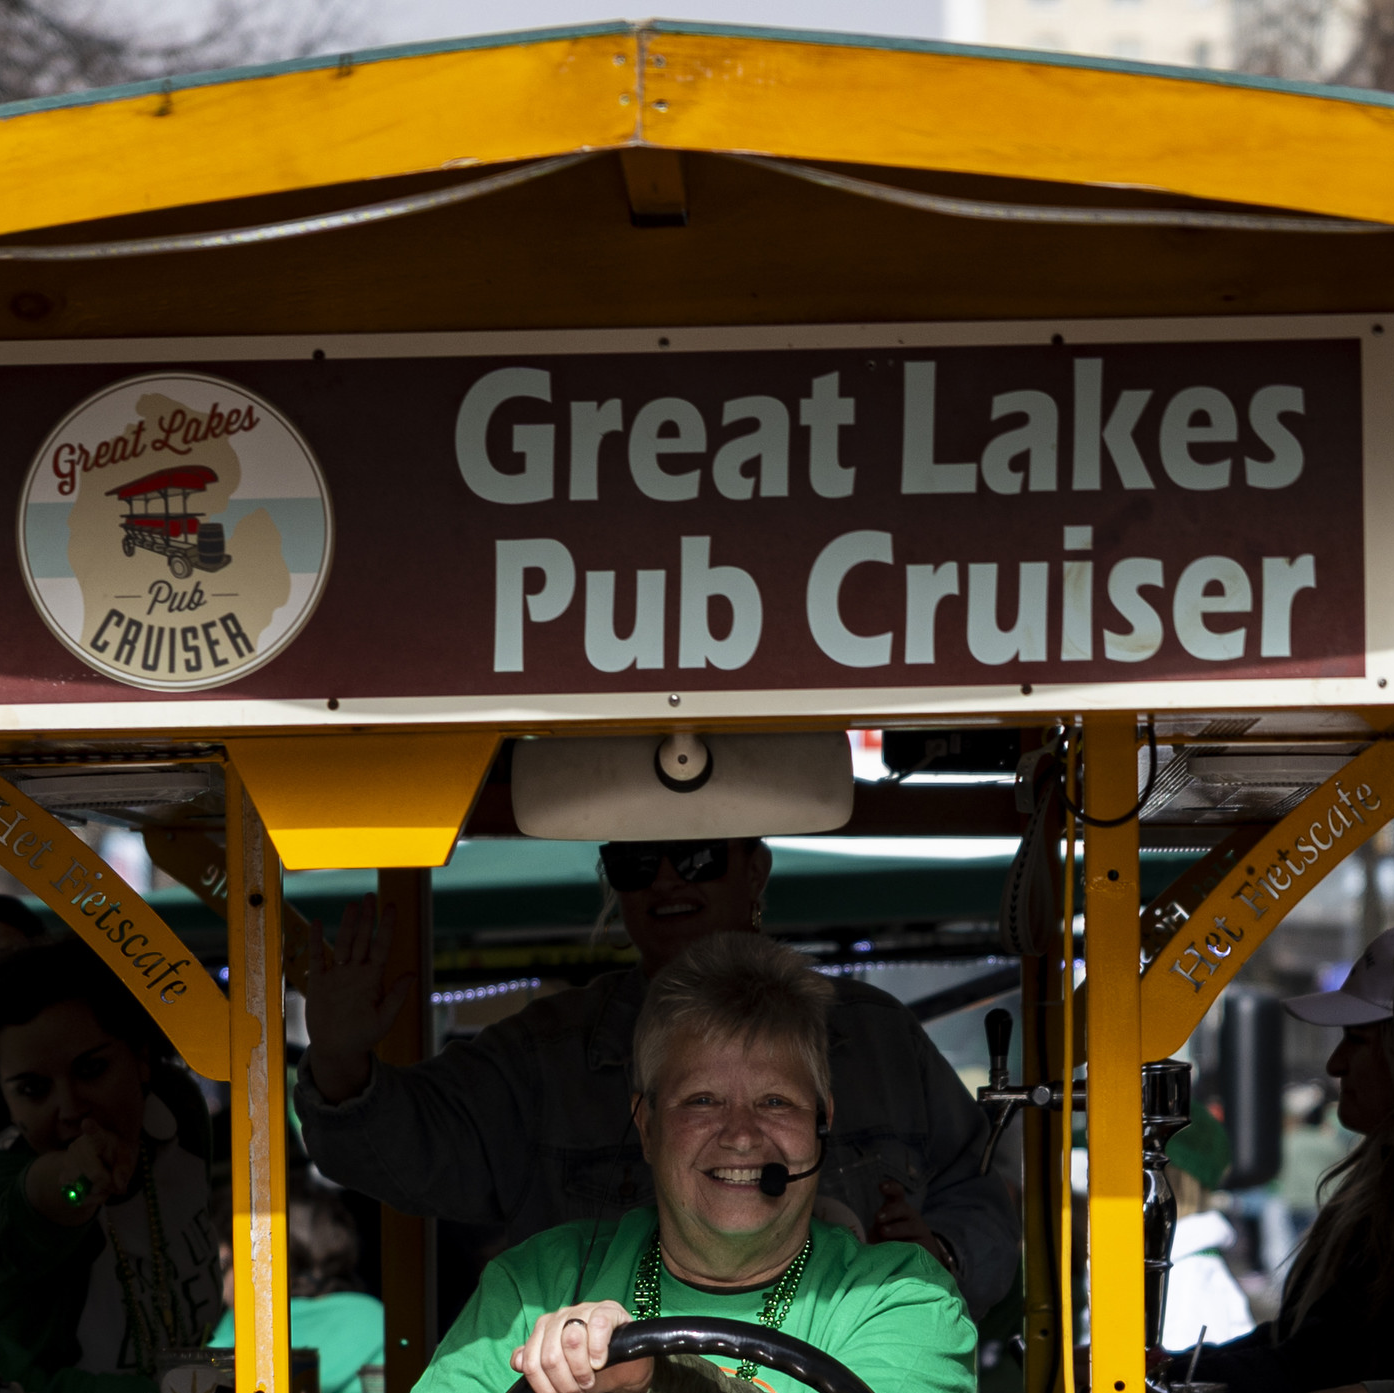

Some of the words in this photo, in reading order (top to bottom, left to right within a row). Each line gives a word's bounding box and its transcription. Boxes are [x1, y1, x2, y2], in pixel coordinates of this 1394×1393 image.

[53, 420, 147, 496] Great
[151, 402, 260, 455] Lakes
[456, 367, 856, 505] Great
[901, 357, 1307, 495] Lakes
[90, 608, 255, 674] CRUISER
[147, 580, 207, 615] Pub
[493, 535, 764, 674] Pub
[806, 526, 1318, 668] Cruiser
[49, 857, 191, 1005] Fietscafe
[1168, 915, 1245, 993] Het
[1230, 780, 1382, 921] Fietscafe
